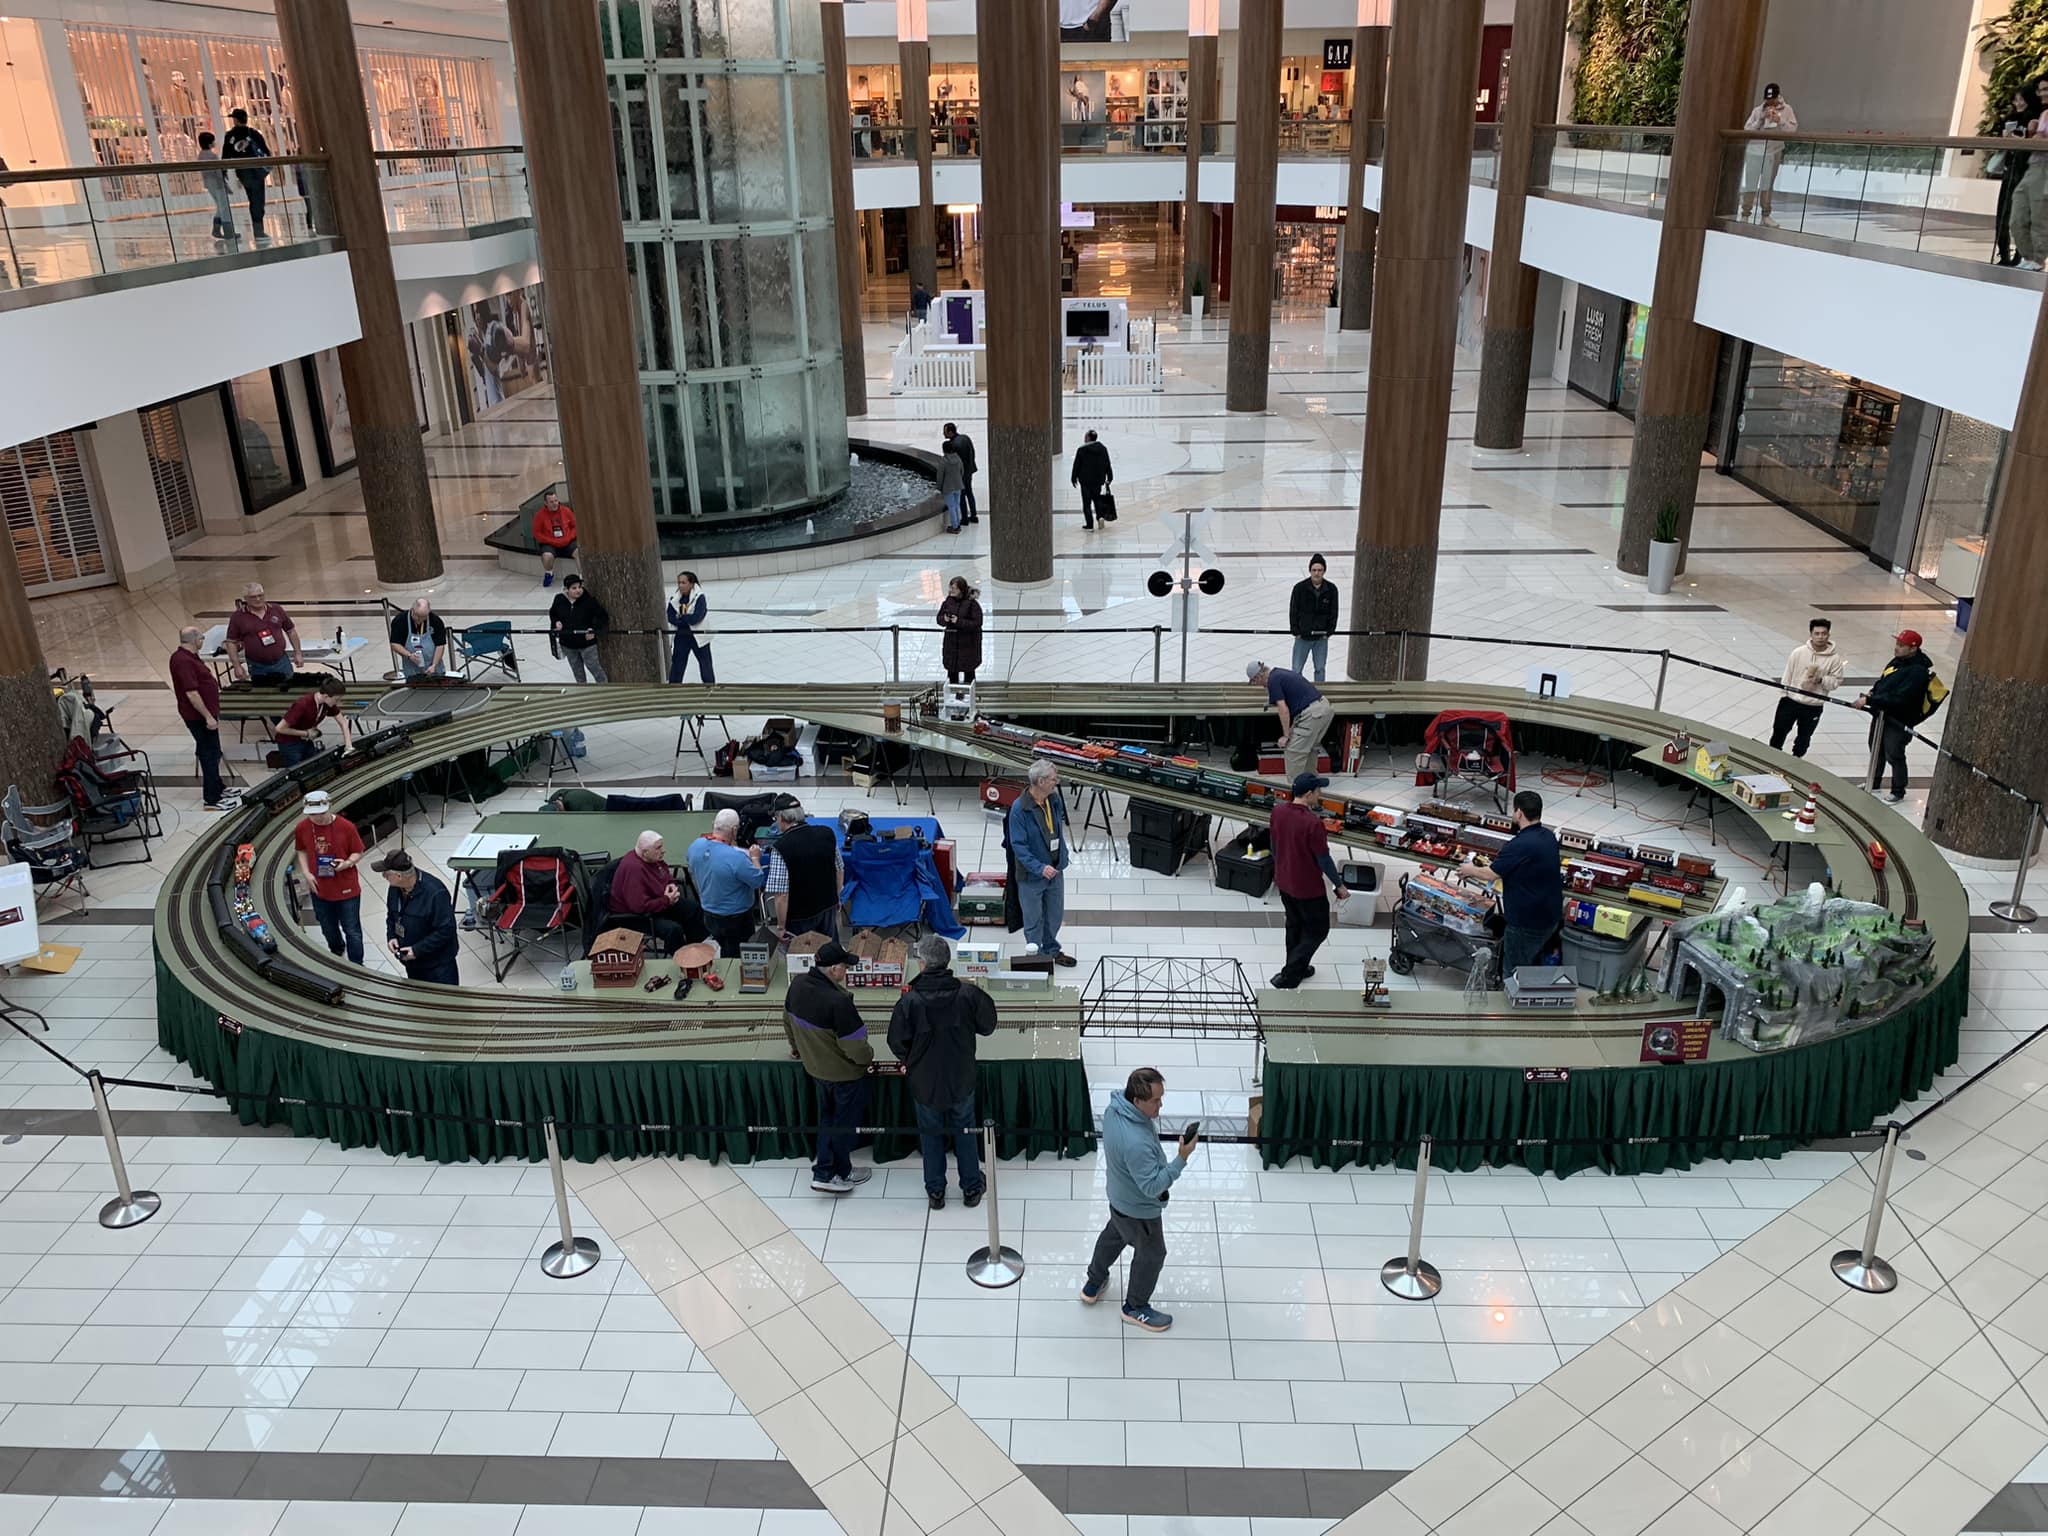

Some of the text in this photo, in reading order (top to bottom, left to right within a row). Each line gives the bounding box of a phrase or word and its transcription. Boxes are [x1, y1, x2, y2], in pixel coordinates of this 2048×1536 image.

[1328, 45, 1349, 60] GAP
[1071, 101, 1095, 121] GAP
[1315, 205, 1338, 219] MUJI
[1586, 306, 1605, 328] LUSH
[1584, 323, 1603, 342] FRESH
